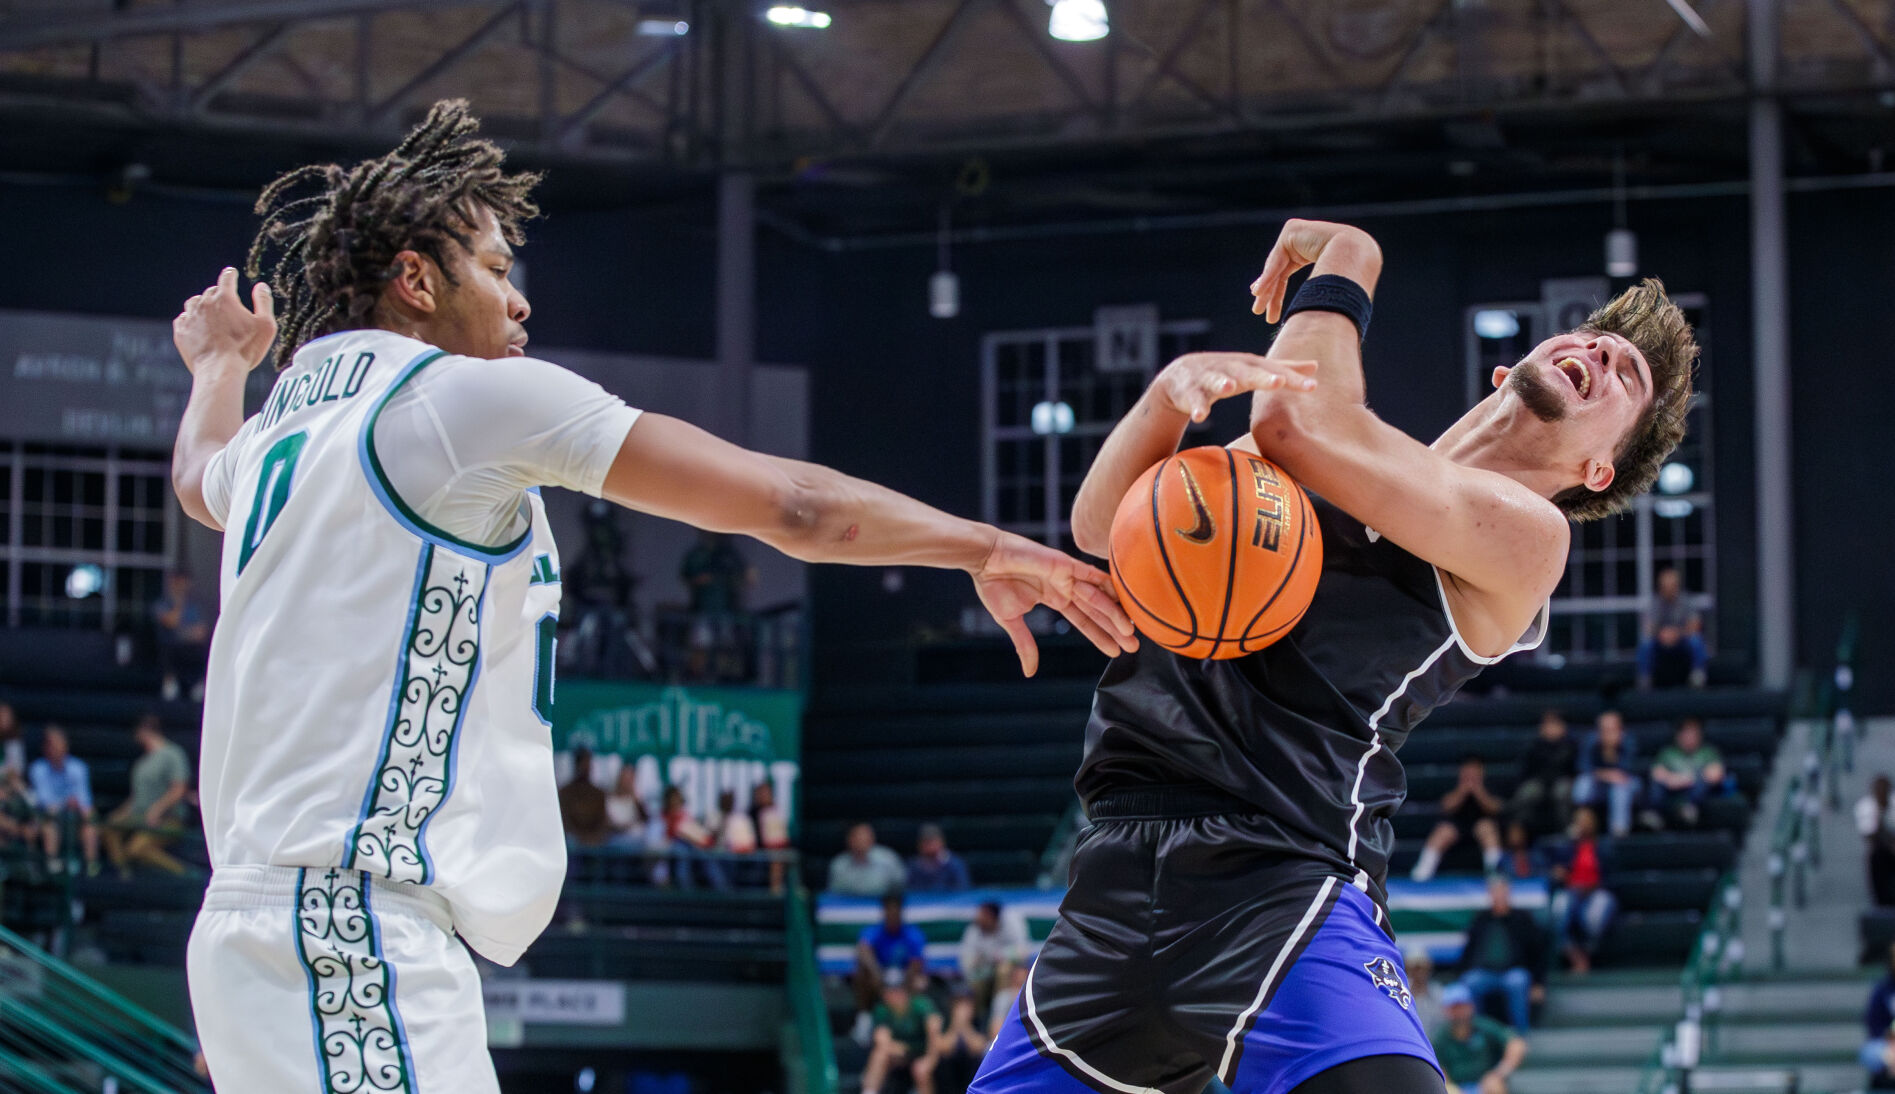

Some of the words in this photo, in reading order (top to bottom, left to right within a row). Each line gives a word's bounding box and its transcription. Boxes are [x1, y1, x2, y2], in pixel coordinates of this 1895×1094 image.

[1110, 328, 1142, 362] N
[237, 428, 309, 577] 0
[1247, 458, 1283, 552] ELITE
